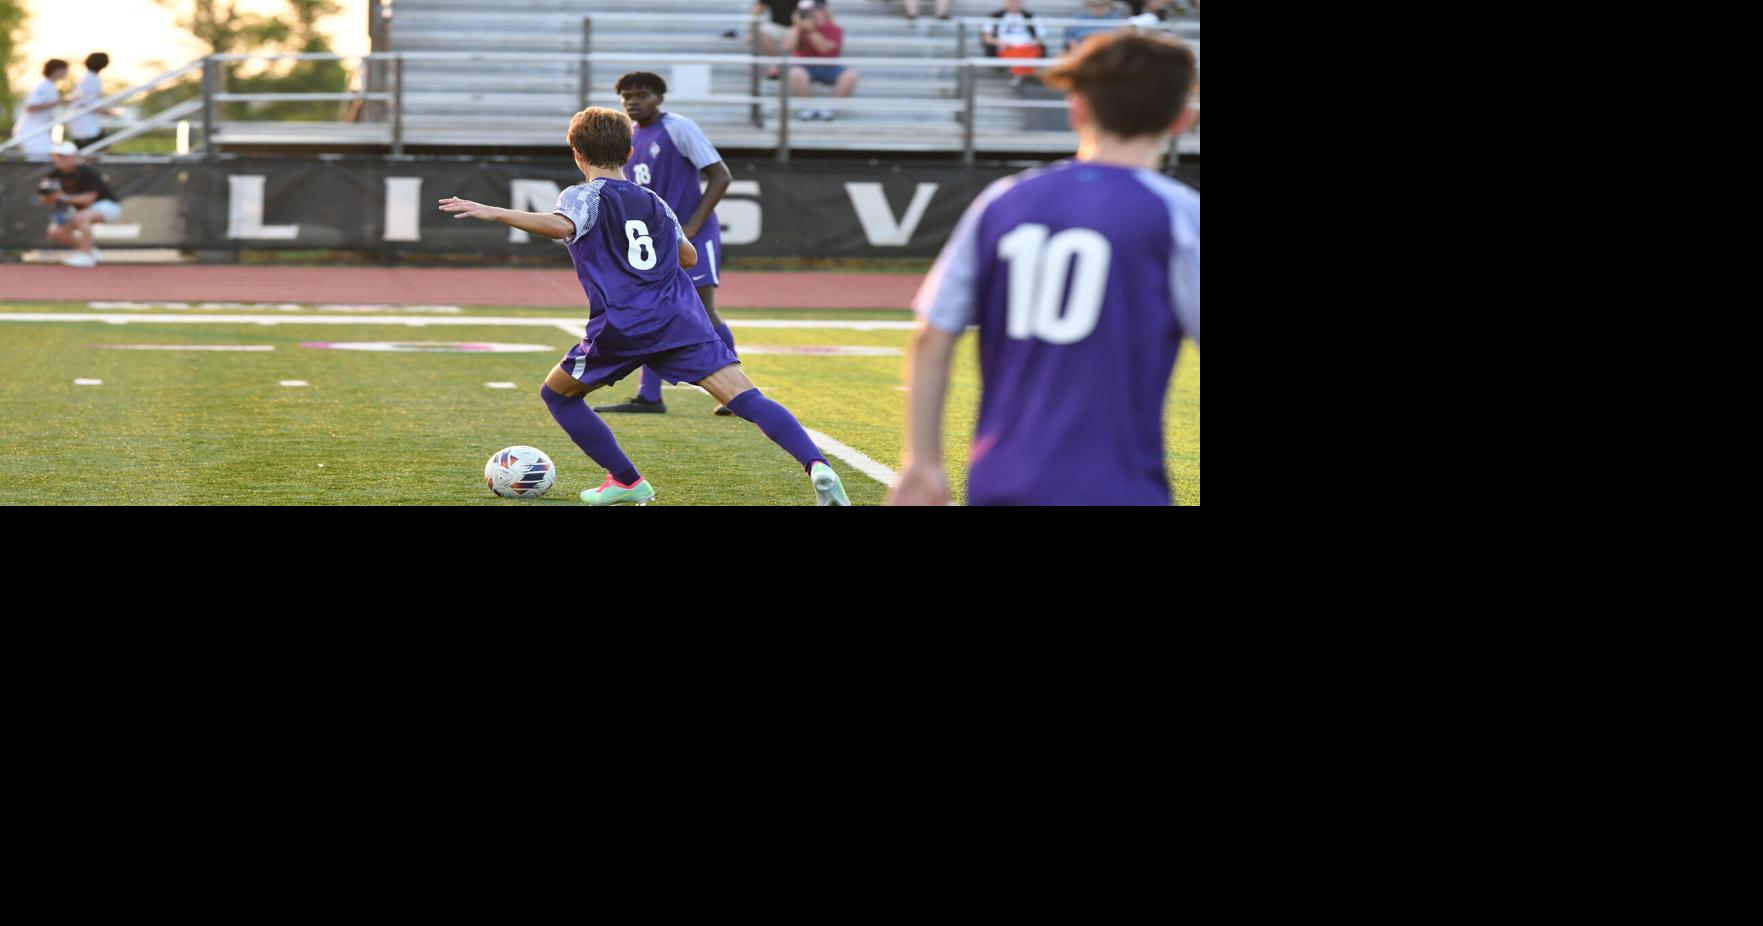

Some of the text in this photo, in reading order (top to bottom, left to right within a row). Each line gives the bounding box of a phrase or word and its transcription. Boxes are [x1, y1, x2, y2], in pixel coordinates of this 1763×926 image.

[633, 163, 651, 185] 18
[625, 219, 657, 270] 6
[997, 222, 1112, 344] 10
